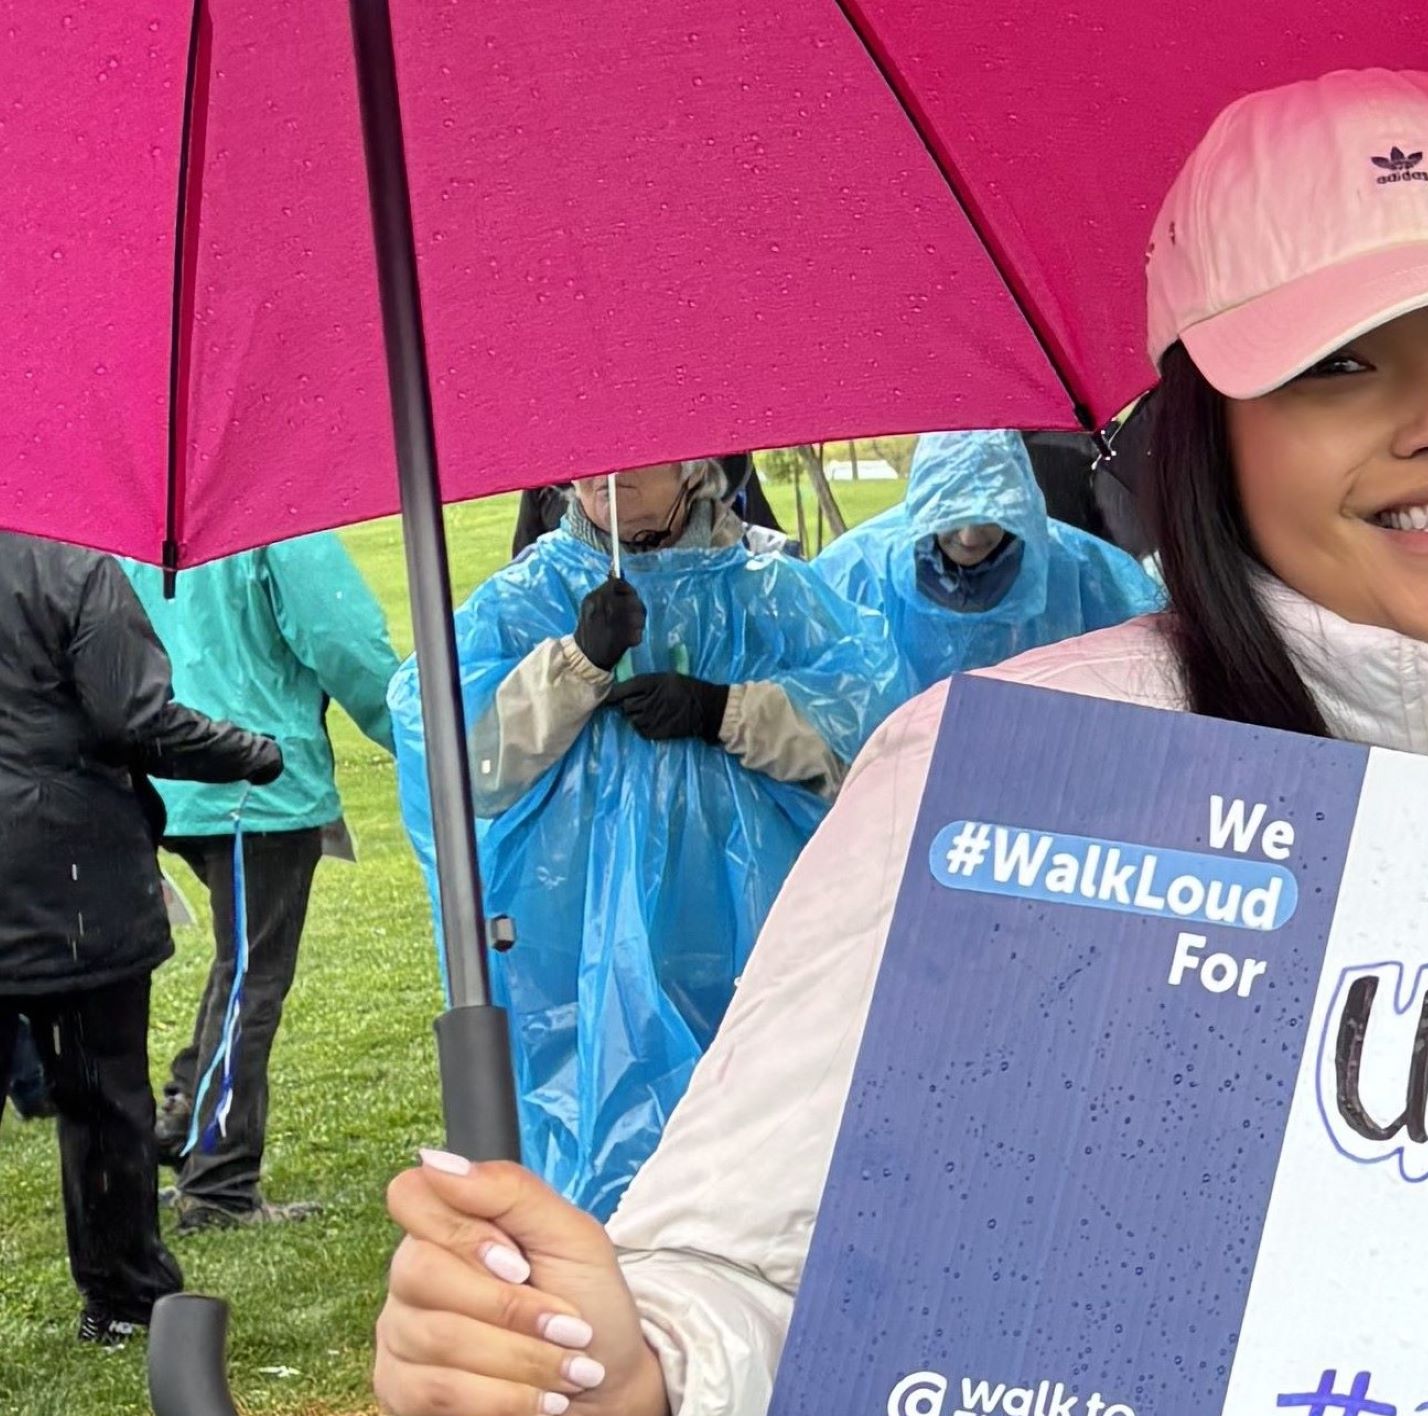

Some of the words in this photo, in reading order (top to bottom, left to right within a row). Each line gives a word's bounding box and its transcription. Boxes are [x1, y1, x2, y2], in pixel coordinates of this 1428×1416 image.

[1210, 795, 1295, 860] We
[946, 820, 1284, 930] #WalkLoud
[1168, 932, 1267, 998] For
